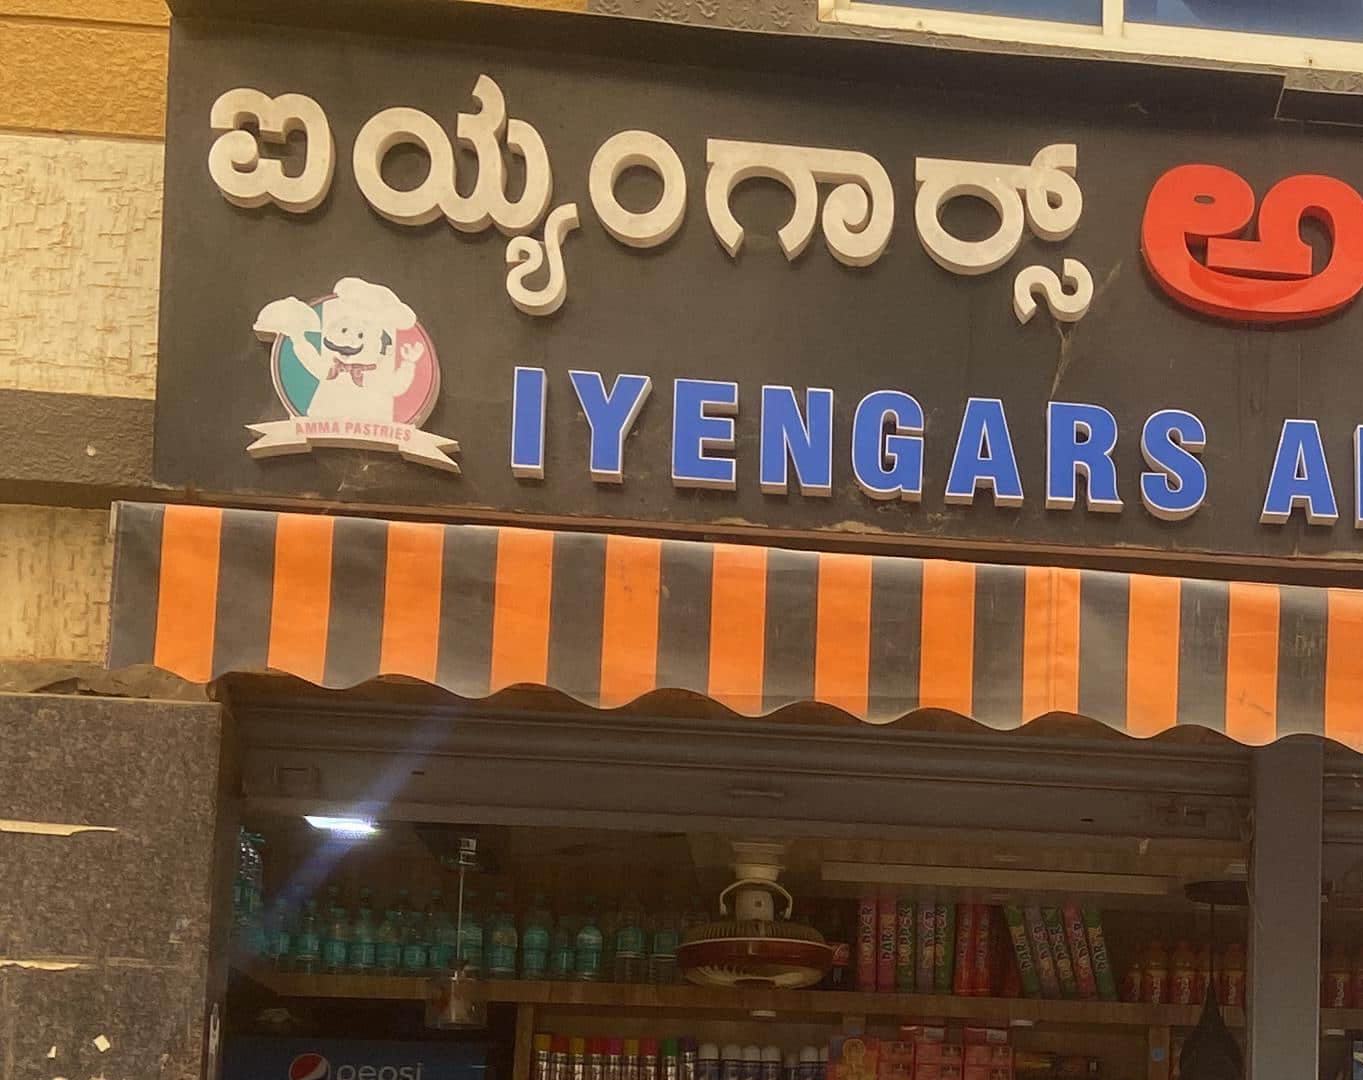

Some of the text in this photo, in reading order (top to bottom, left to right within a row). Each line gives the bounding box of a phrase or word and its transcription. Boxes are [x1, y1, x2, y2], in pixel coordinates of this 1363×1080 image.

[295, 420, 413, 442] AMMA PASTRIES
[510, 366, 1209, 522] IYENGARS
